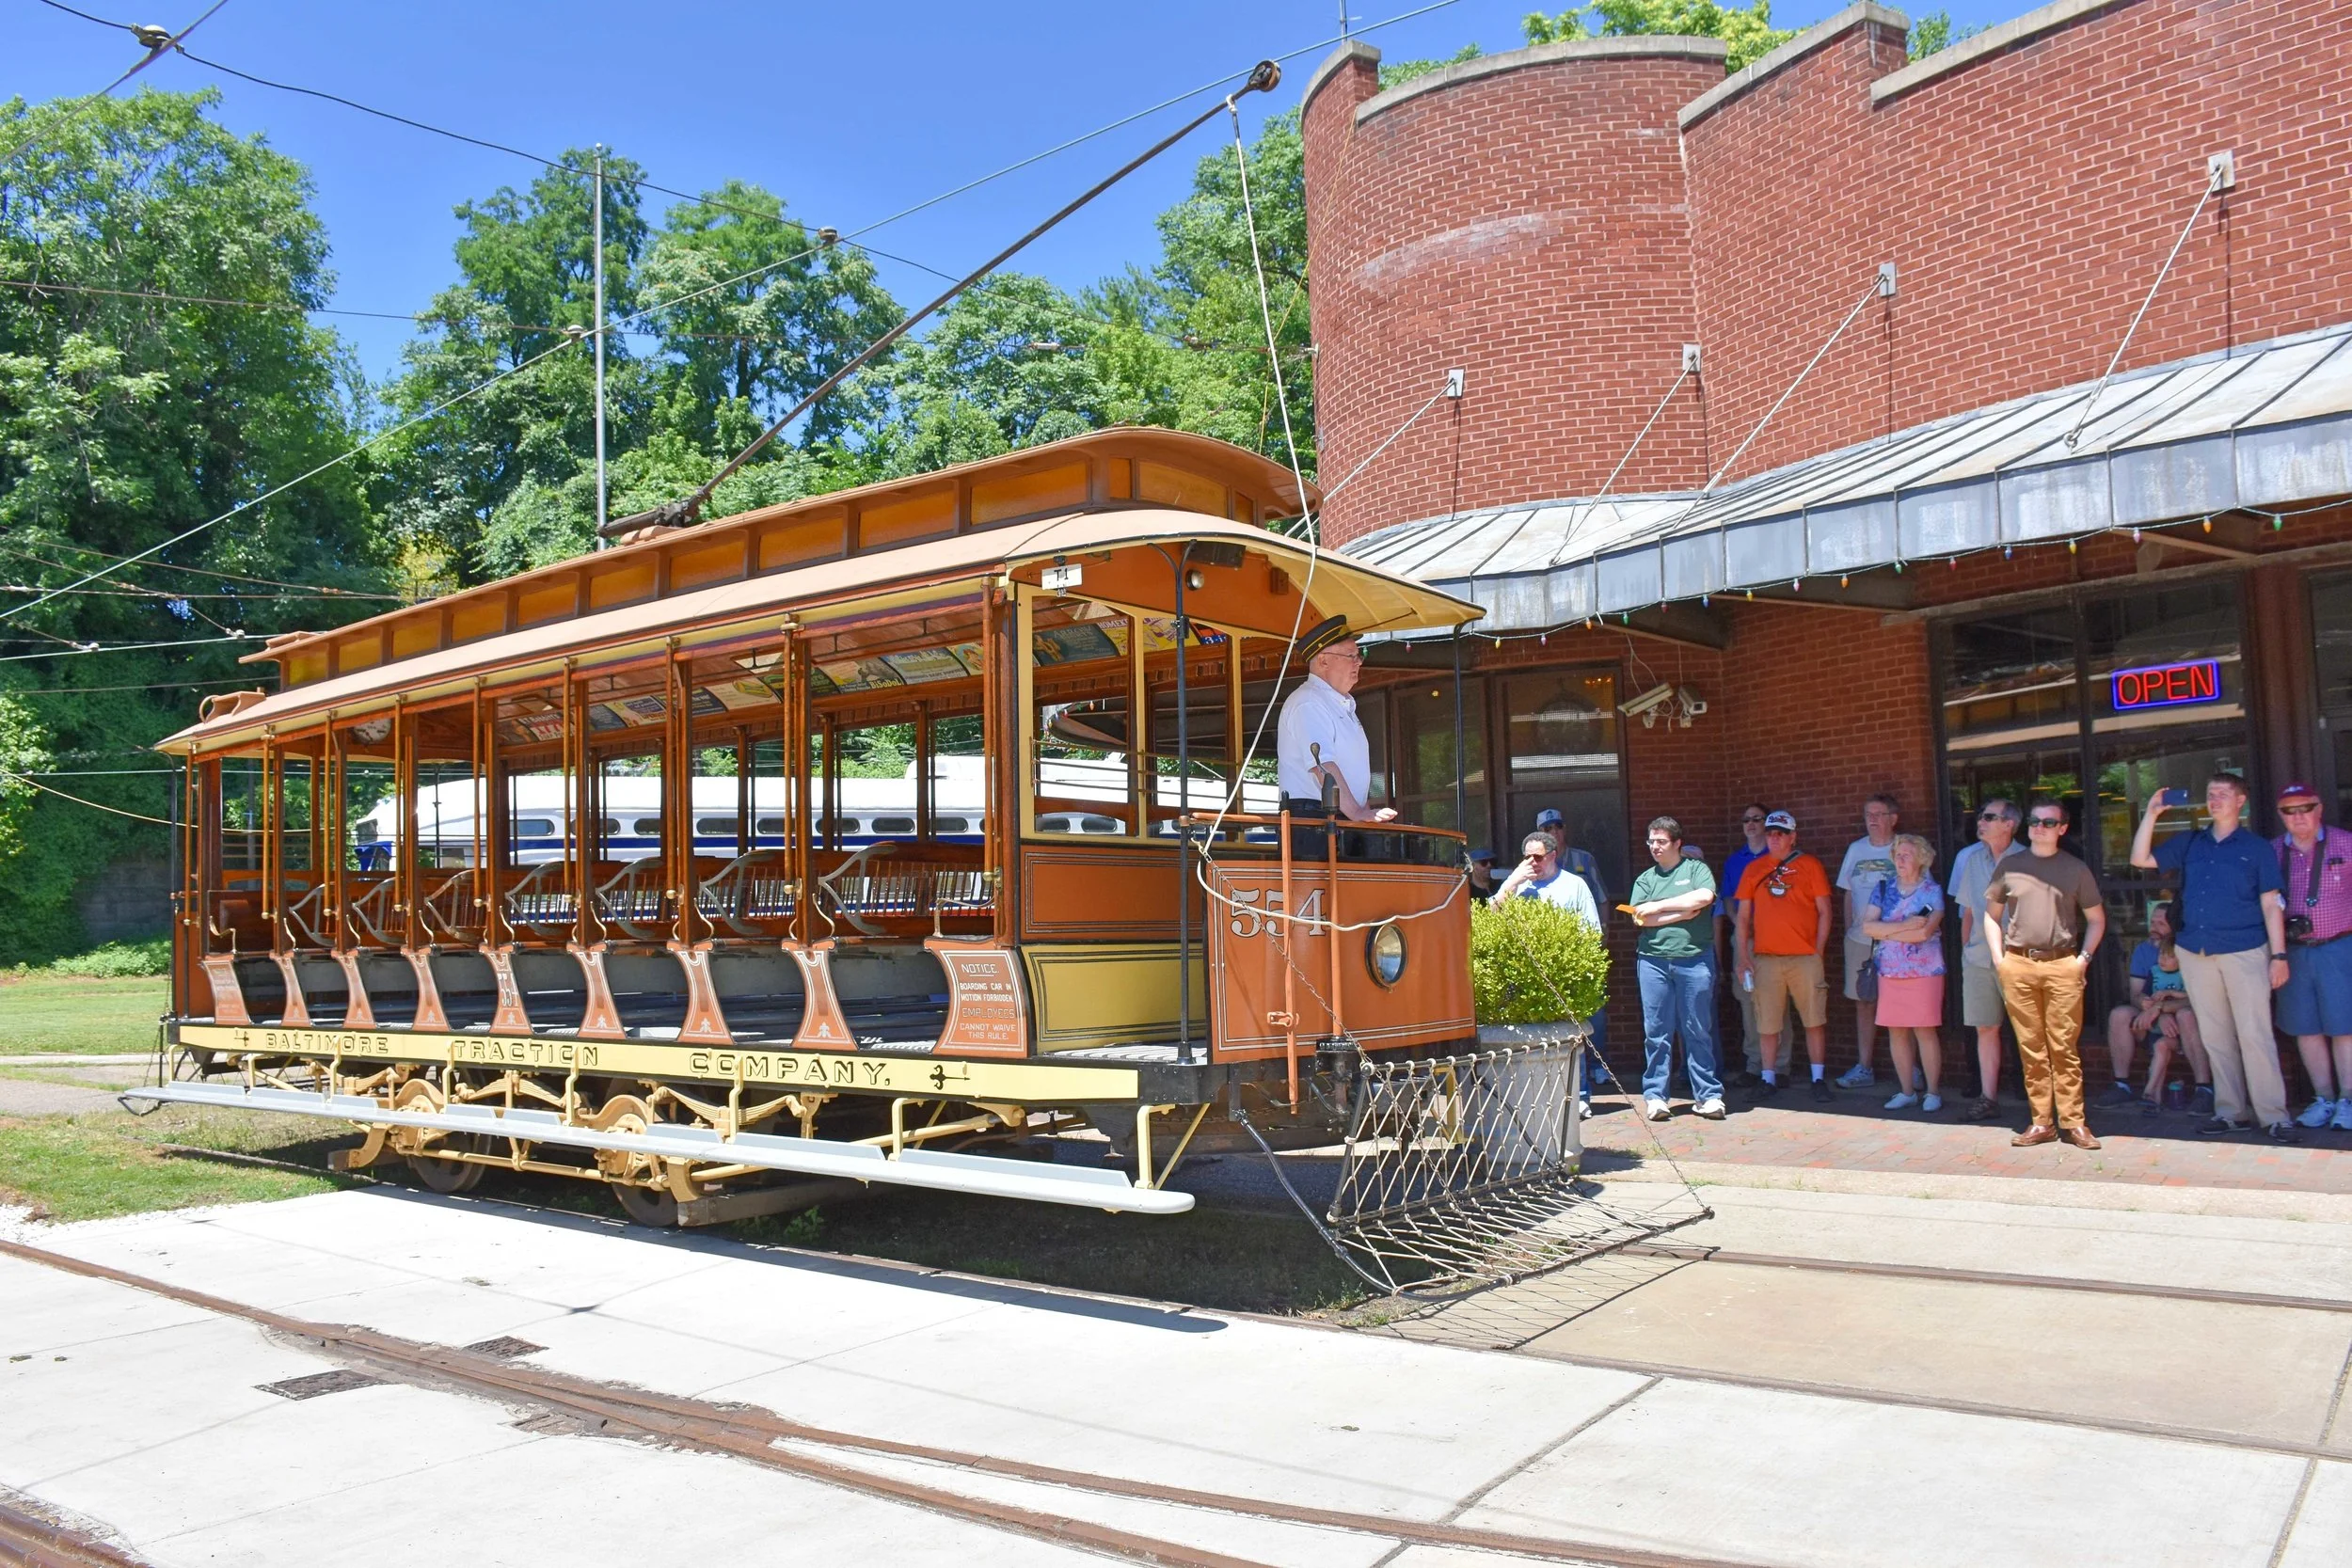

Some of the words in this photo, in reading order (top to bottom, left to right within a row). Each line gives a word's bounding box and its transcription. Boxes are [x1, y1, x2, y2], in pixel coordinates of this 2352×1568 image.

[2119, 663, 2214, 705] OPEN
[1231, 888, 1327, 938] 554
[961, 993, 982, 1002] MOTION
[962, 1007, 1015, 1019] EMPLOYEES
[993, 1023, 1016, 1032] WAIVE
[265, 1033, 389, 1053] BALTIMORE
[454, 1040, 598, 1066] TRACTION
